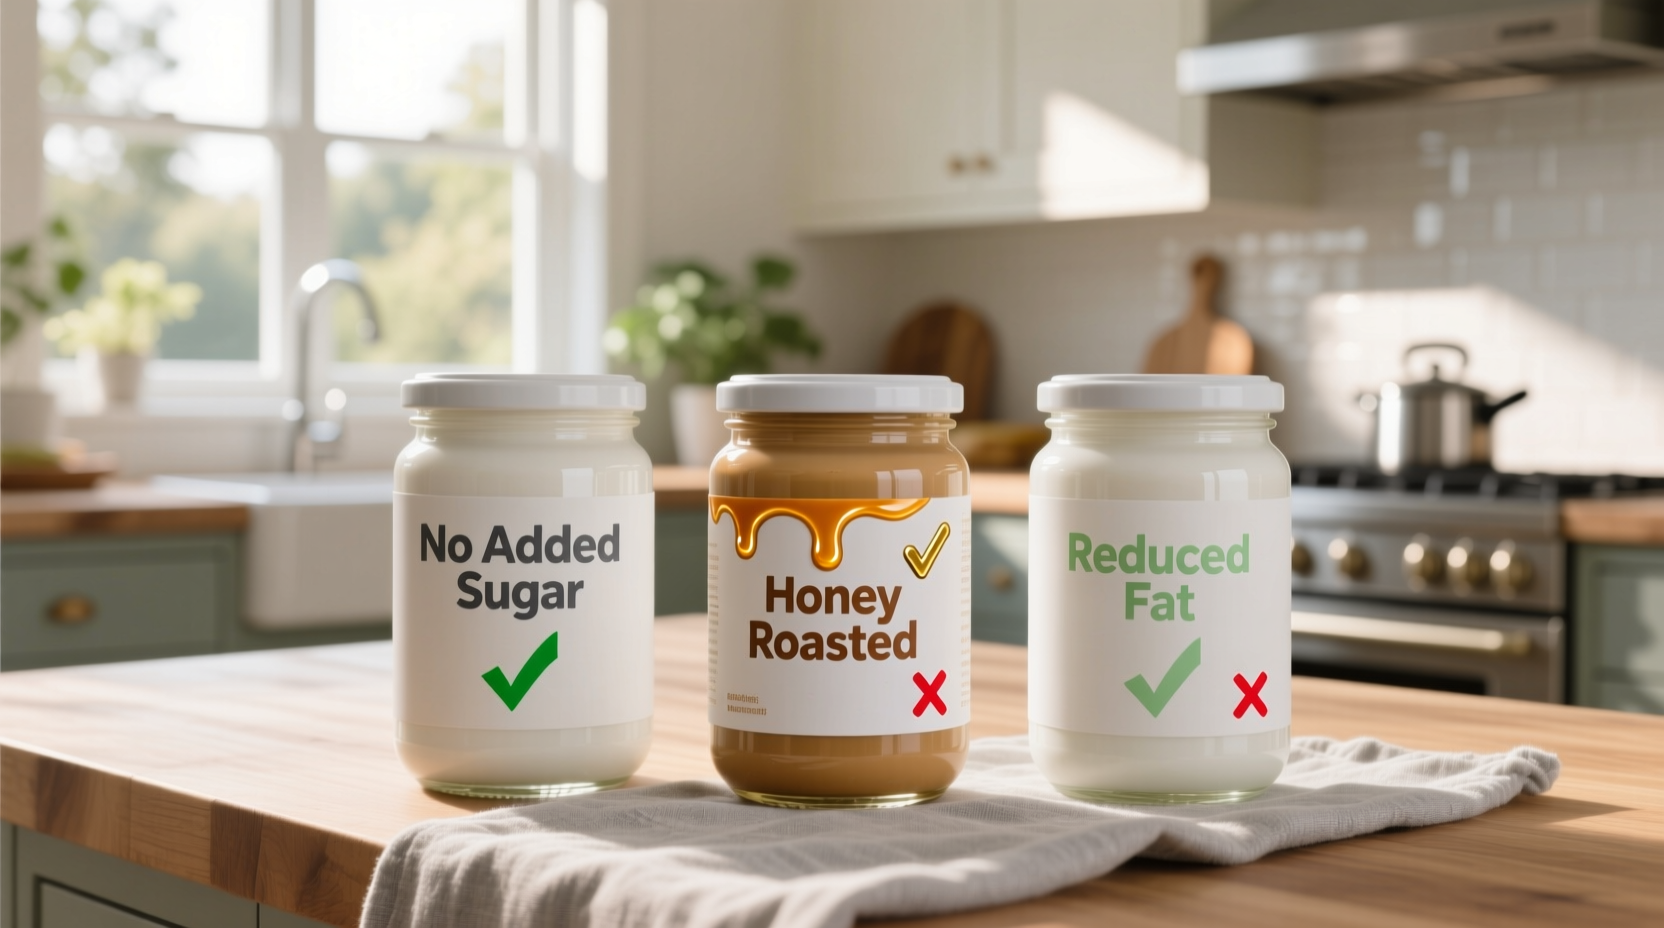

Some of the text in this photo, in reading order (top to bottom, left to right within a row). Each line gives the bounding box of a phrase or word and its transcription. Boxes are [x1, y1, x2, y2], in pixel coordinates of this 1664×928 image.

[420, 523, 620, 564] No Added
[1068, 532, 1250, 575] Reduced
[456, 571, 584, 621] Sugar
[766, 575, 902, 625] Honey
[1125, 581, 1196, 622] Fat
[749, 620, 917, 661] Roasted
